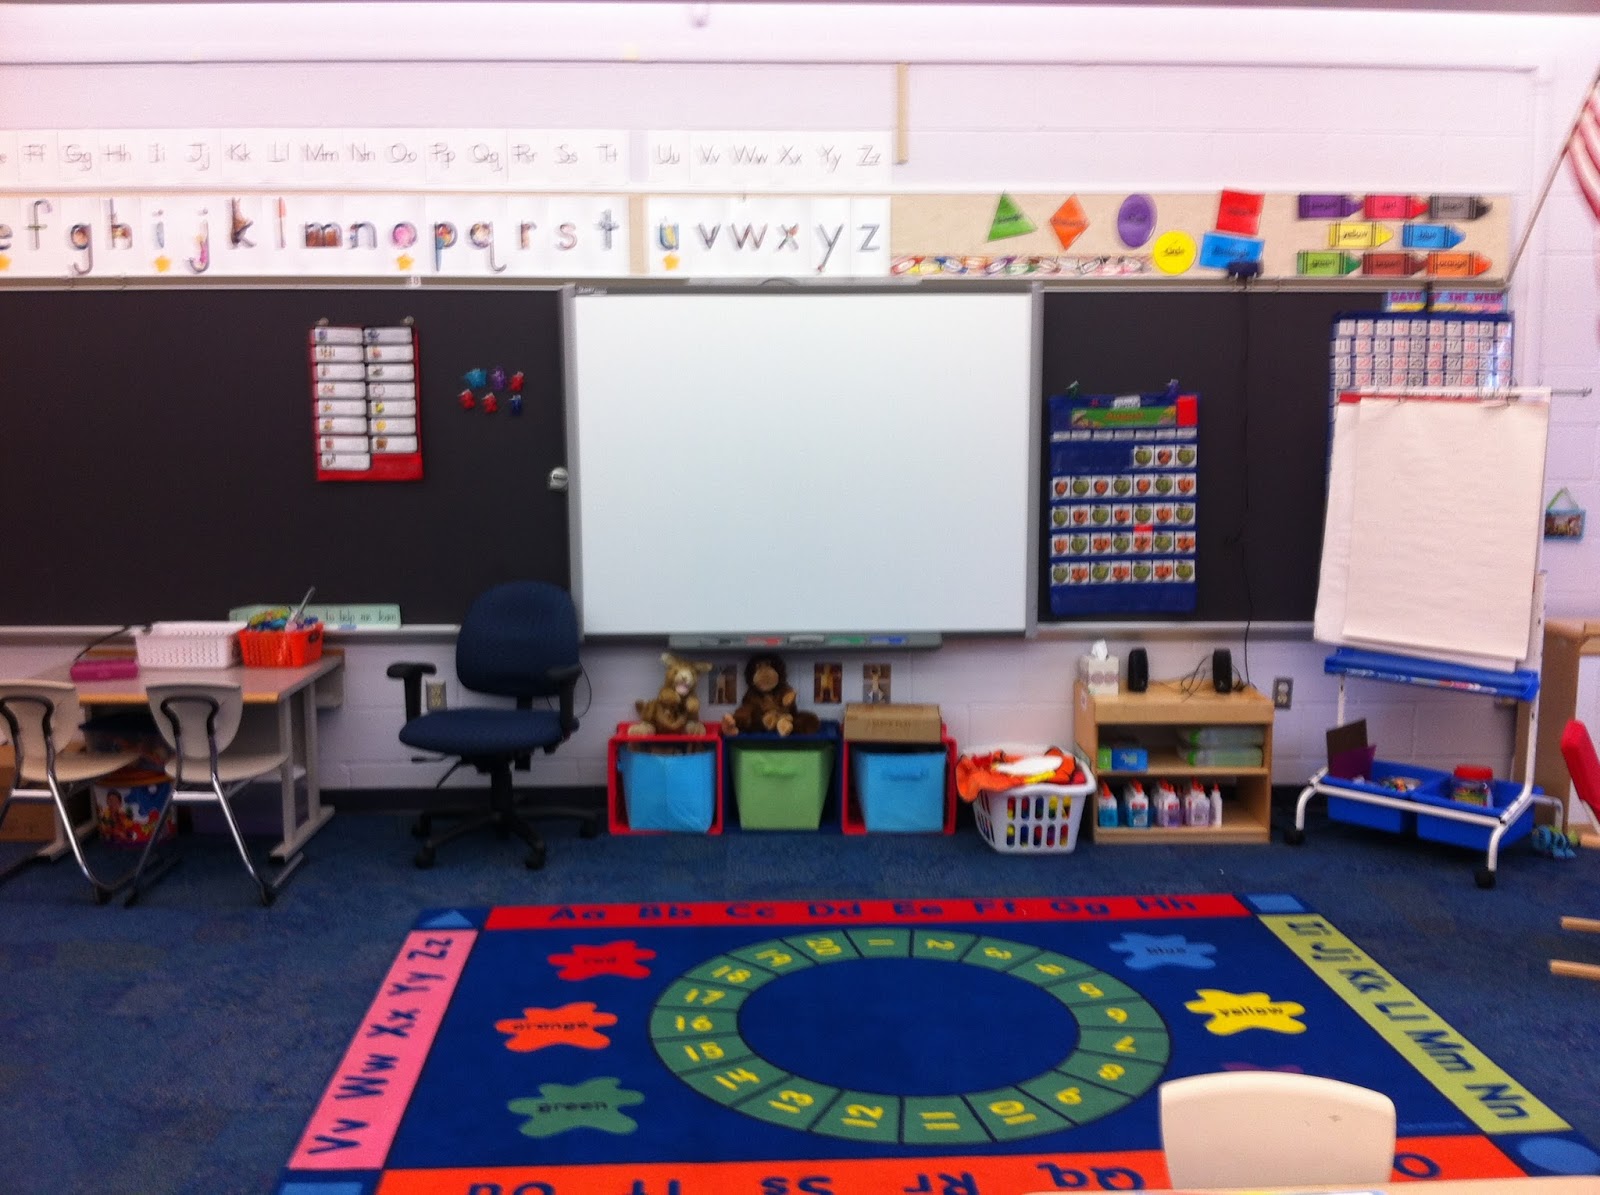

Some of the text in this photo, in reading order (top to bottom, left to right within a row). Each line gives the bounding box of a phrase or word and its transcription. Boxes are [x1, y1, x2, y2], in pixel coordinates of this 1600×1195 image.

[26, 198, 53, 250] f
[70, 222, 94, 275] g
[103, 197, 133, 250] h
[153, 208, 166, 249] i
[188, 208, 211, 273] j
[230, 196, 258, 250] k
[304, 220, 344, 250] m
[349, 220, 379, 250] n
[391, 221, 418, 250] o
[434, 220, 459, 273] p
[469, 220, 508, 274] q
[519, 219, 538, 250] r
[555, 221, 579, 251] s
[596, 207, 620, 251] t
[657, 221, 681, 251] u
[697, 222, 722, 250] v
[730, 222, 769, 250] w
[777, 222, 800, 250] x
[817, 222, 845, 274] y
[858, 222, 881, 251] z
[339, 609, 356, 624] help
[548, 897, 1198, 921] Aa Bb Cc Dd Ee Ff Gg Hh
[926, 939, 956, 951] 2
[1145, 944, 1187, 957] blue
[582, 954, 618, 966] red
[684, 988, 726, 1006] 17
[1216, 1004, 1286, 1019] yellow
[511, 1019, 590, 1032] orange
[675, 1015, 714, 1033] 16
[1310, 941, 1363, 963] Jj
[1338, 967, 1393, 995] Kk
[1374, 1000, 1431, 1022] Ll
[1403, 1029, 1477, 1073] Mm
[1463, 1082, 1531, 1121] Nn
[307, 937, 455, 1155] Vv Ww Xx Yy Zz
[683, 1041, 725, 1063] 15
[1112, 1035, 1137, 1054] 7
[713, 1067, 761, 1092] 14
[537, 1099, 609, 1115] green
[768, 1089, 815, 1114] 13
[988, 1099, 1038, 1126] 10
[841, 1103, 885, 1130] 12
[918, 1110, 961, 1132] 11
[1037, 1160, 1147, 1191] Qq
